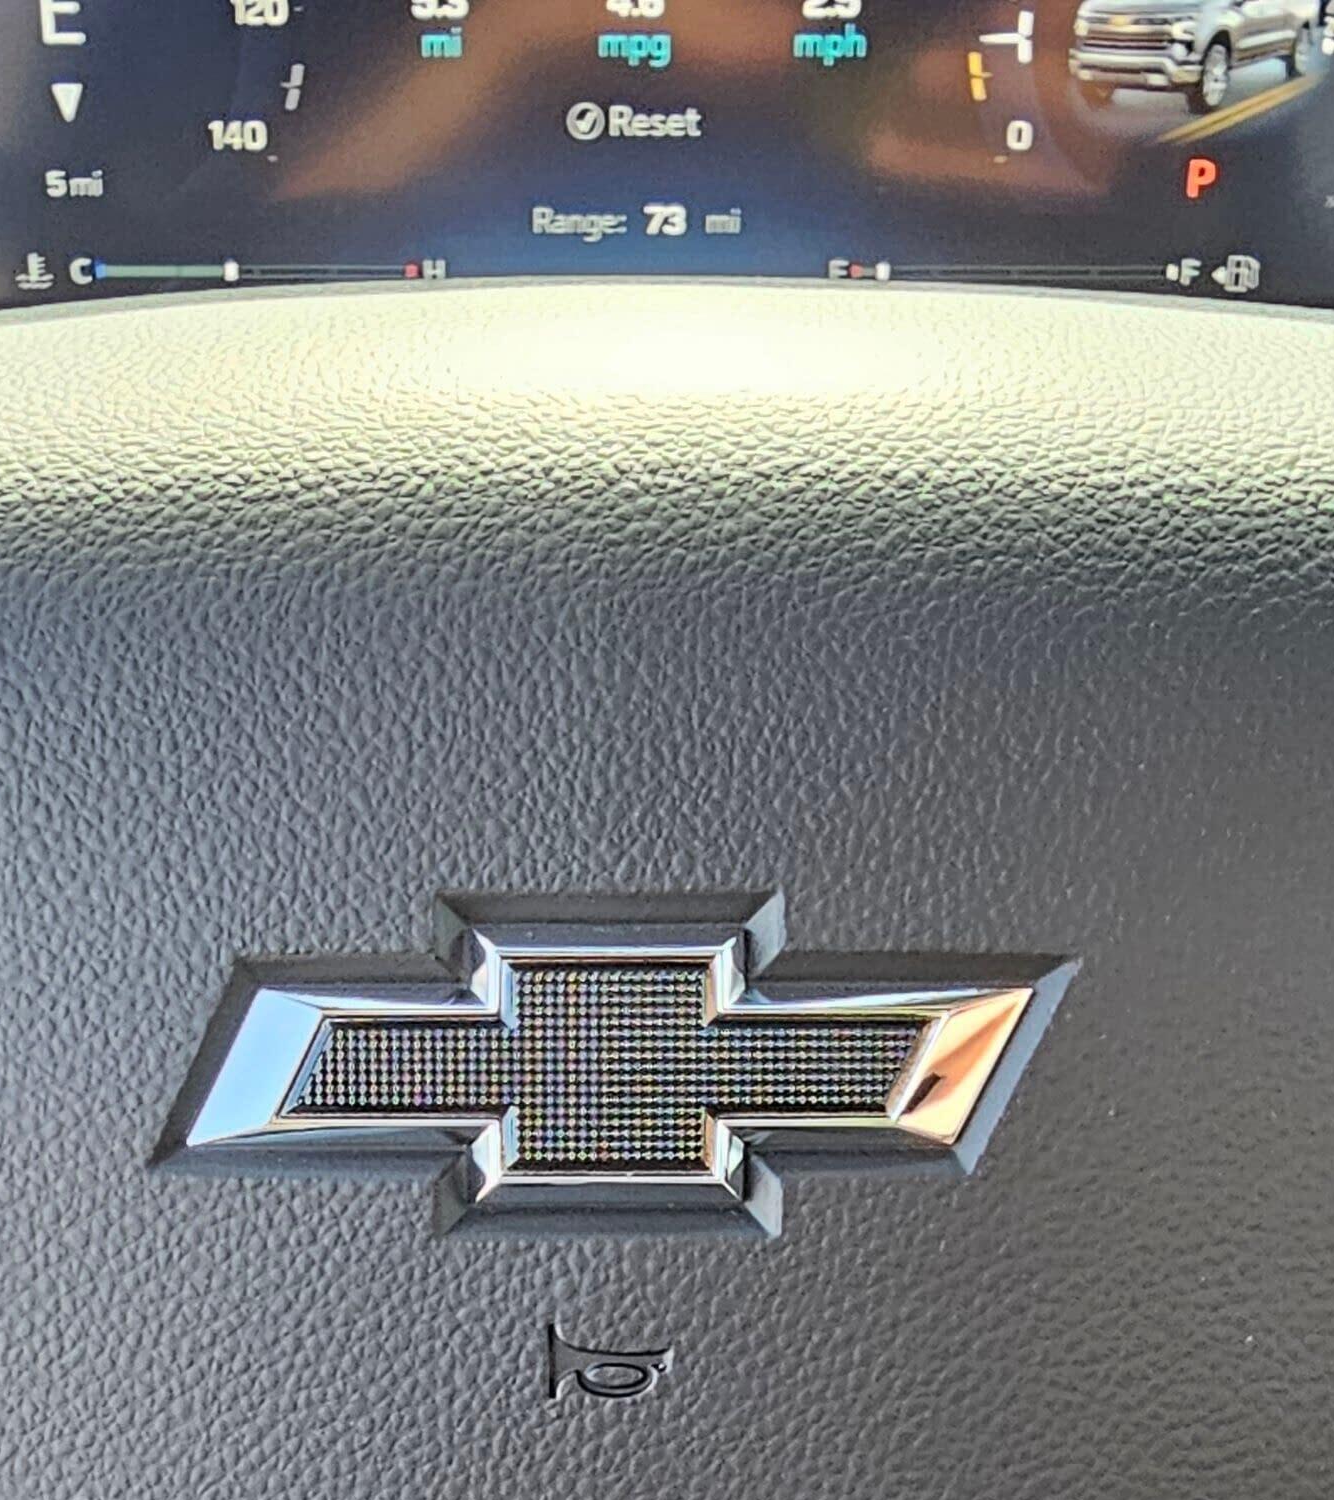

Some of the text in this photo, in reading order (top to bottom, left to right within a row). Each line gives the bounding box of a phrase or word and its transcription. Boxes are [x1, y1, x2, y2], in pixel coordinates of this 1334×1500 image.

[229, 0, 290, 26] 120
[420, 26, 463, 58] mi
[597, 33, 672, 68] mpg
[793, 22, 868, 67] mph
[207, 120, 268, 151] 140
[608, 104, 702, 137] Reset
[1006, 120, 1033, 151] 0
[1186, 158, 1216, 198] P
[531, 203, 742, 242] Range: 73 mi
[69, 257, 93, 285] C
[422, 259, 446, 280] H
[1179, 258, 1202, 286] F
